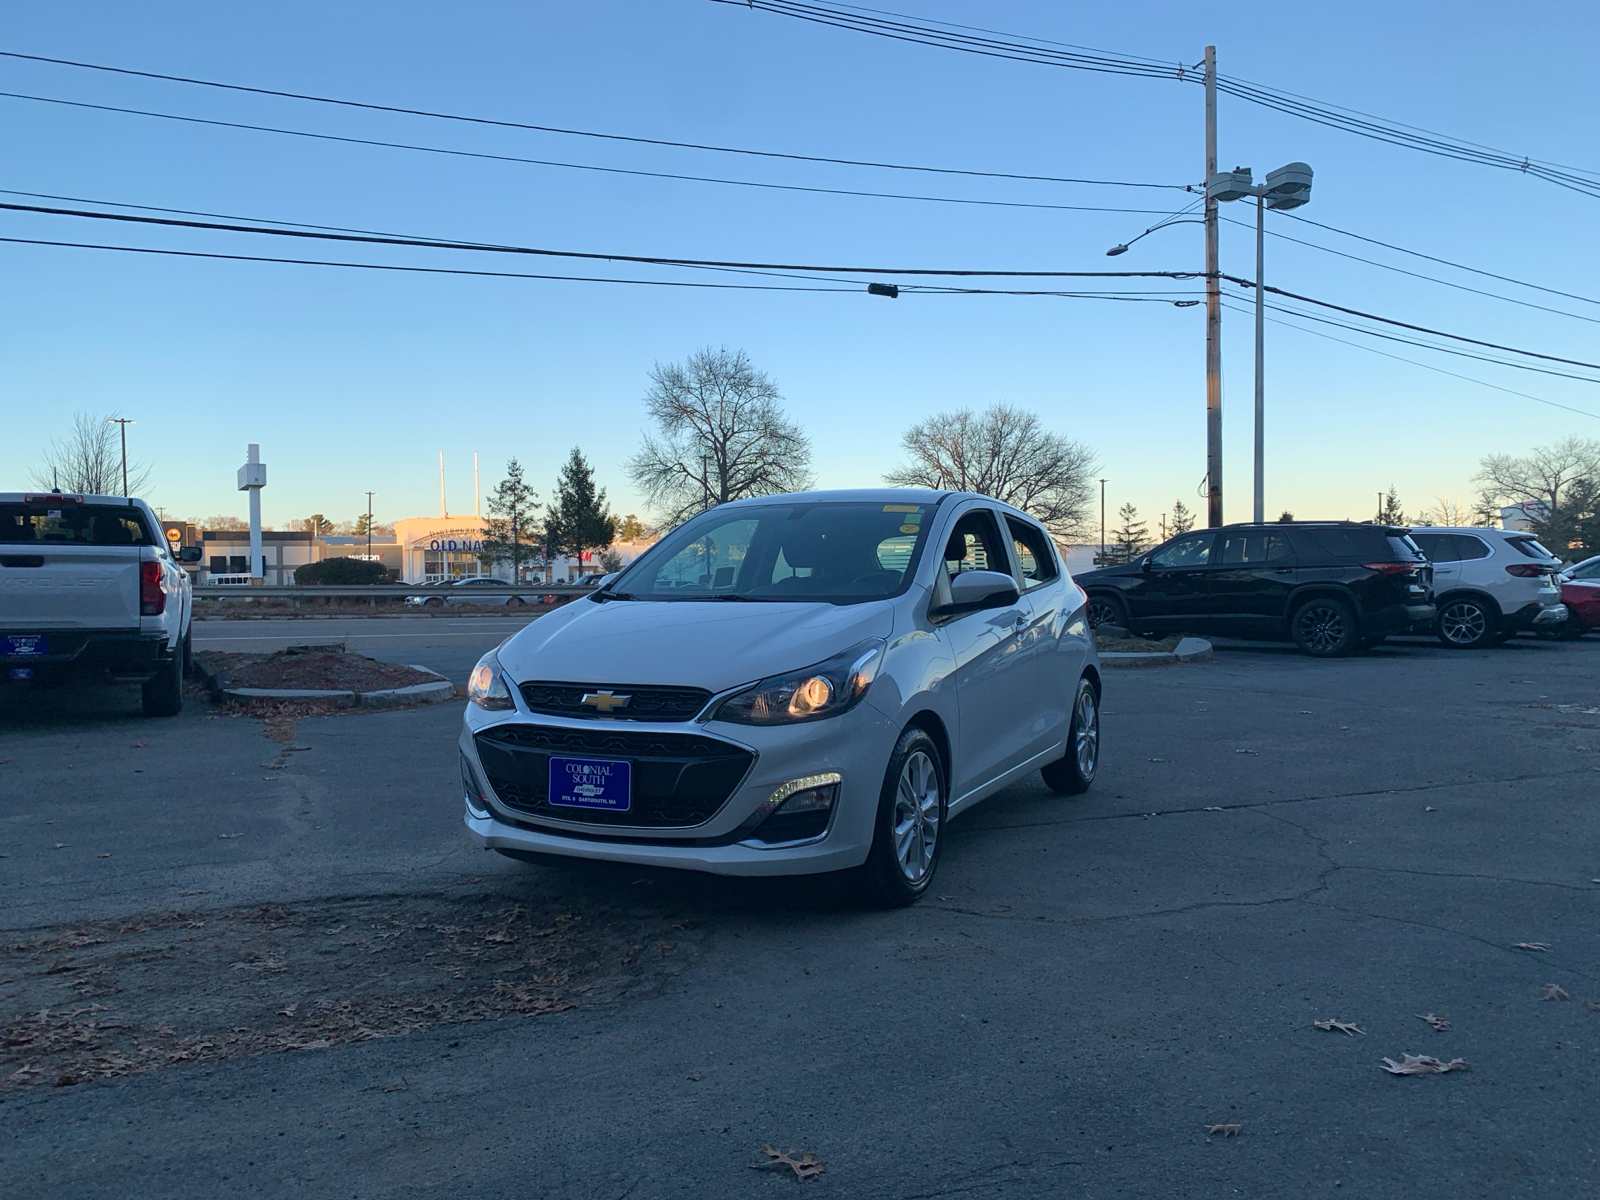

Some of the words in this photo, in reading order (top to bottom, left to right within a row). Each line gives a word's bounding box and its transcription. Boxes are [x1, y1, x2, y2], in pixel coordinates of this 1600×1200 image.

[430, 539, 457, 552] OLD
[462, 540, 490, 552] NA
[565, 763, 613, 776] COLONIAL
[572, 774, 605, 785] SOUTH
